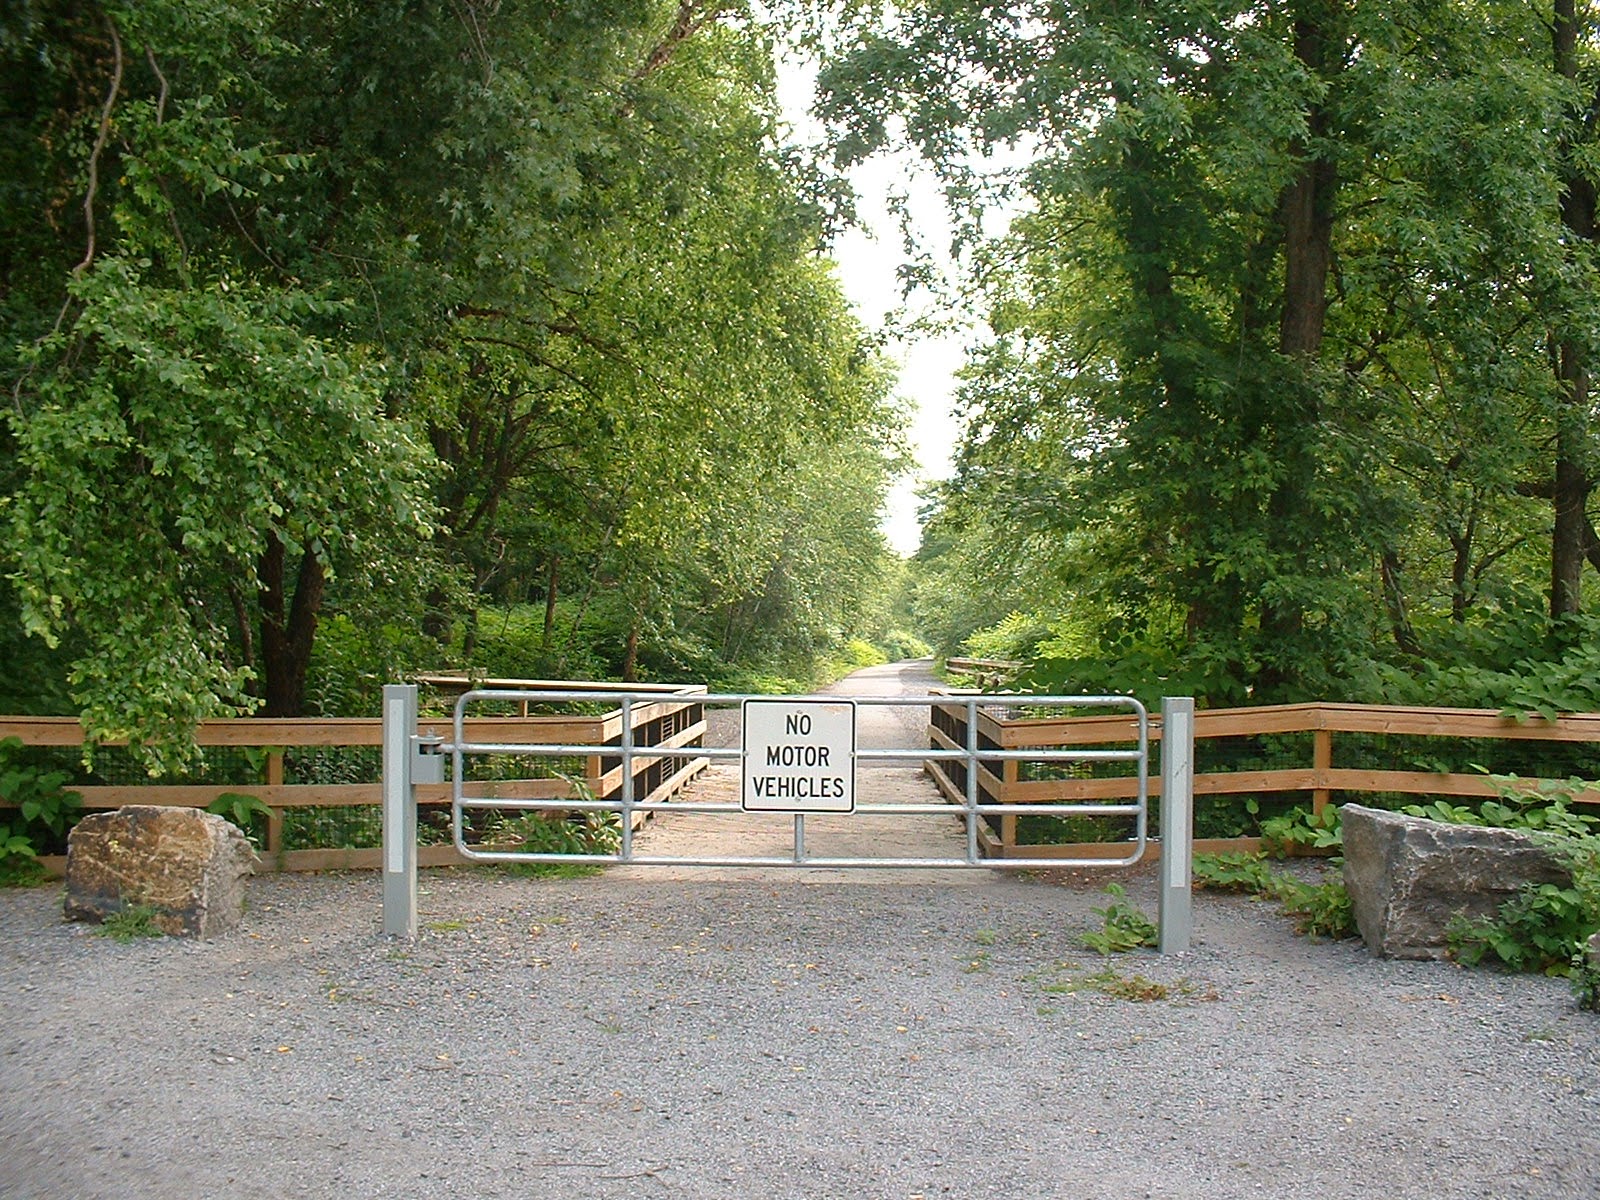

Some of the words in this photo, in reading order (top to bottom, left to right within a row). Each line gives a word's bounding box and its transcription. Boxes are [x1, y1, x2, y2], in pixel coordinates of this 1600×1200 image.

[786, 714, 812, 736] NO
[766, 745, 830, 767] MOTOR
[752, 776, 844, 798] VEHICLES
